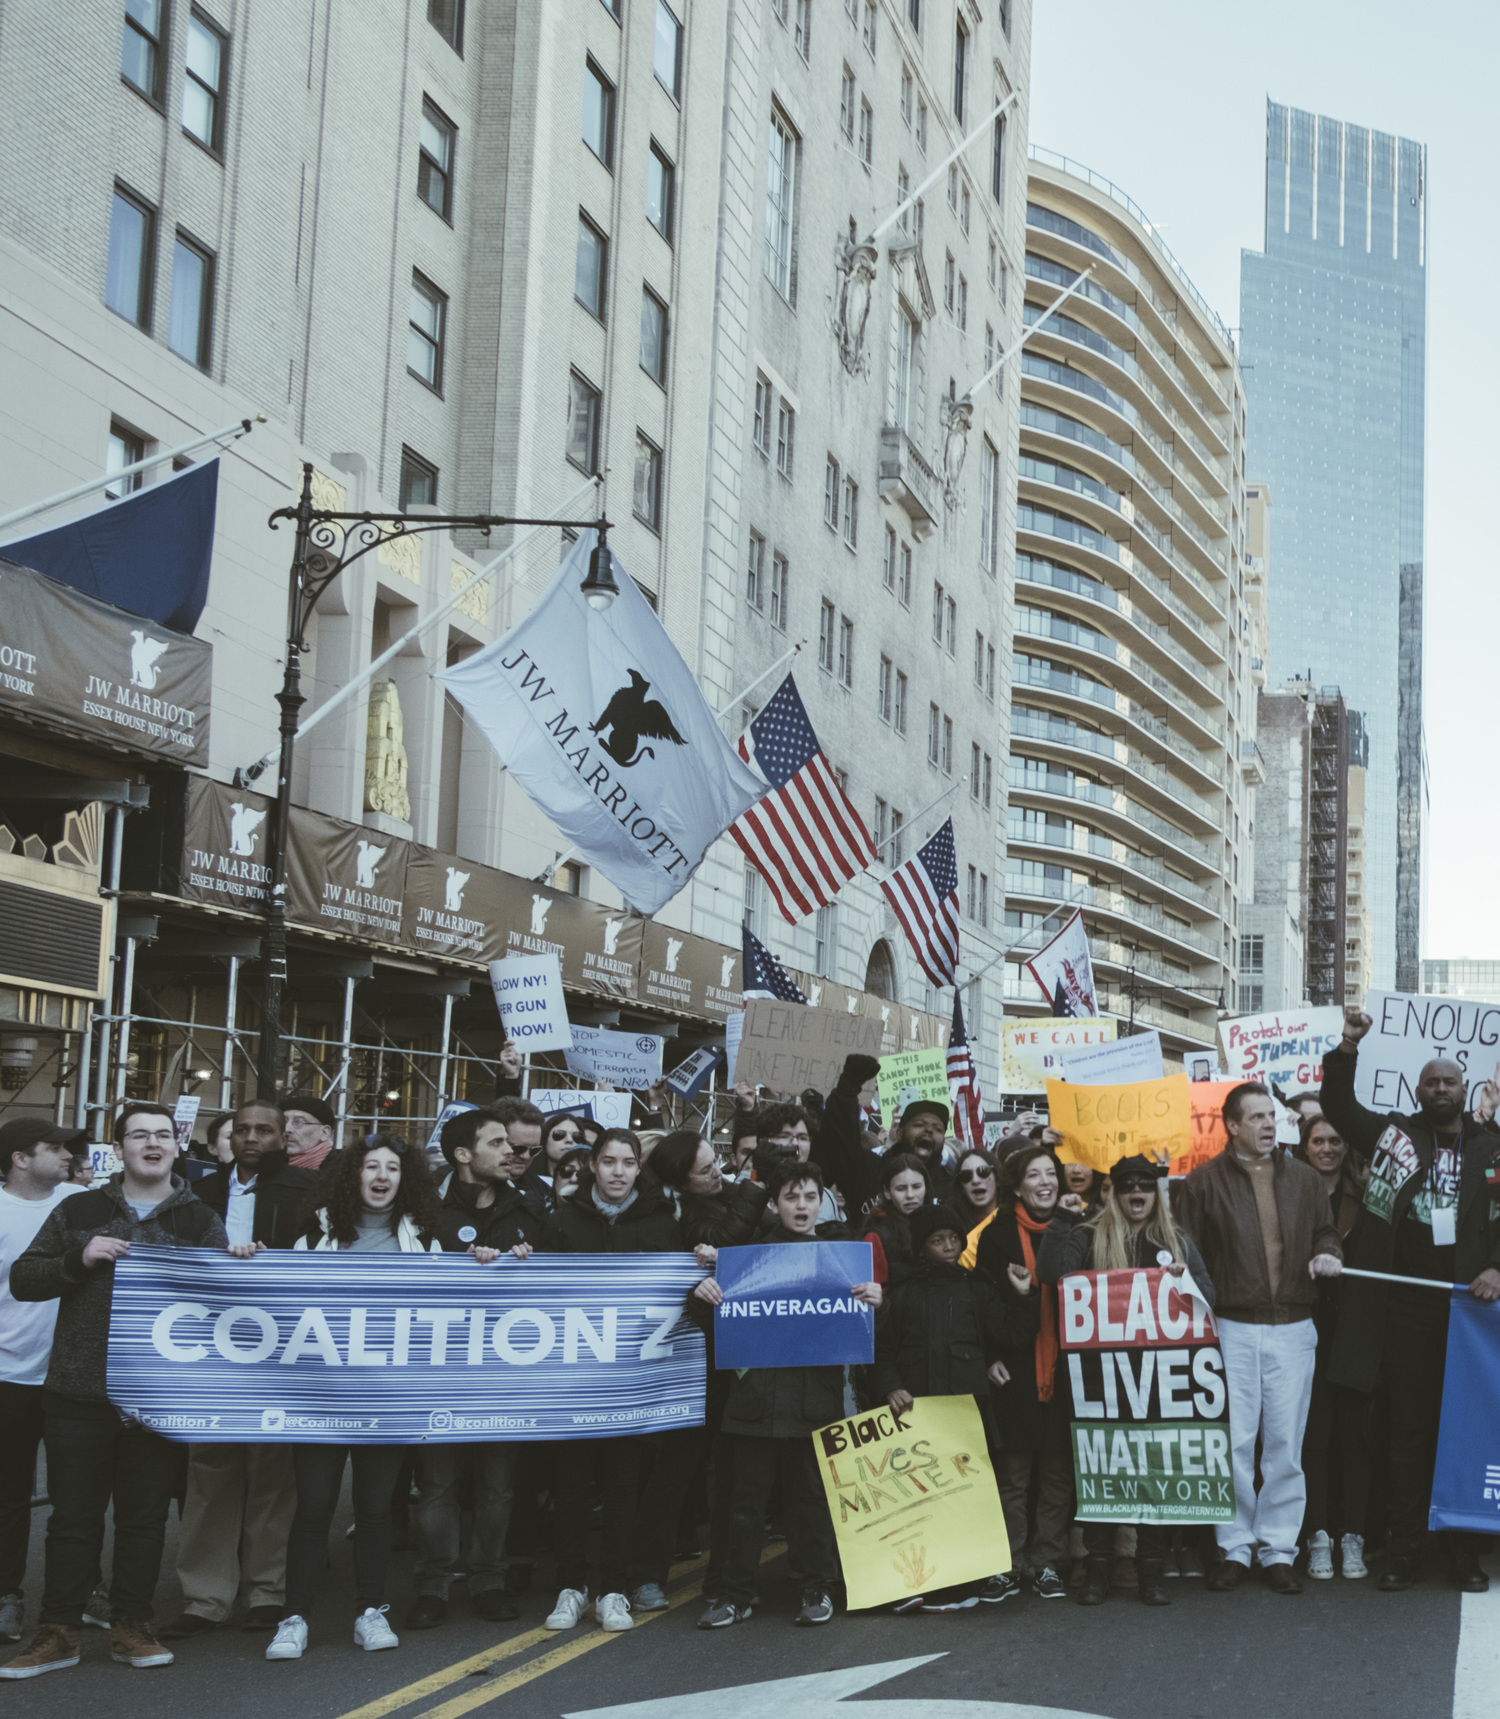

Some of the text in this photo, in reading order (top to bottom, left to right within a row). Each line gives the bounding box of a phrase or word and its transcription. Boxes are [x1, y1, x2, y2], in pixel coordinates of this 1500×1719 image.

[4, 675, 35, 696] YORK
[85, 675, 195, 728] JW MARRIOTT
[83, 700, 195, 748] ESSEX HOUSE NEW YORK
[501, 649, 689, 875] JW MARRIOTT
[191, 850, 273, 884] JW MARRIO
[190, 873, 215, 890] ESSEX
[215, 878, 244, 896] HOUSE
[323, 883, 403, 917] JW MARRIOTT
[320, 904, 341, 921] ESSEX
[343, 908, 366, 925] HOUSE
[417, 907, 485, 937] JW MARRIOTT
[416, 926, 433, 939] ESSEX
[433, 931, 454, 944] HOUSE
[508, 931, 565, 958] JW MARRIOTT
[584, 952, 632, 976] JW MARRIOTT
[523, 975, 547, 988] NY!
[648, 970, 692, 991] JW MARRIOTT
[706, 985, 715, 997] JW
[515, 999, 547, 1013] GUN
[511, 1022, 553, 1038] NOW!
[749, 1002, 819, 1043] LEAVE
[1014, 1031, 1110, 1045] WE CALL
[892, 1054, 919, 1066] THIS
[1242, 1034, 1338, 1070] STUDENTS
[622, 1077, 650, 1088] NRA
[879, 1067, 910, 1082] SANDY
[892, 1073, 943, 1091] SURVIVOR
[931, 1086, 949, 1099] FOR
[1074, 1088, 1170, 1127] BOOKS
[719, 1298, 869, 1318] #NEVERAGAIN
[151, 1303, 684, 1366] COALITION Z
[1067, 1347, 1226, 1420] LIVES
[142, 1414, 206, 1428] Coalition
[208, 1415, 221, 1428] Z
[572, 1405, 690, 1424] www.coalitionz.org
[1076, 1428, 1231, 1478] MATTER
[838, 1453, 980, 1523] MATTER
[1082, 1479, 1231, 1502] NEW YORK
[1082, 1503, 1232, 1517] WWW.BLACKLIVESMATTERGREATERNY.COM
